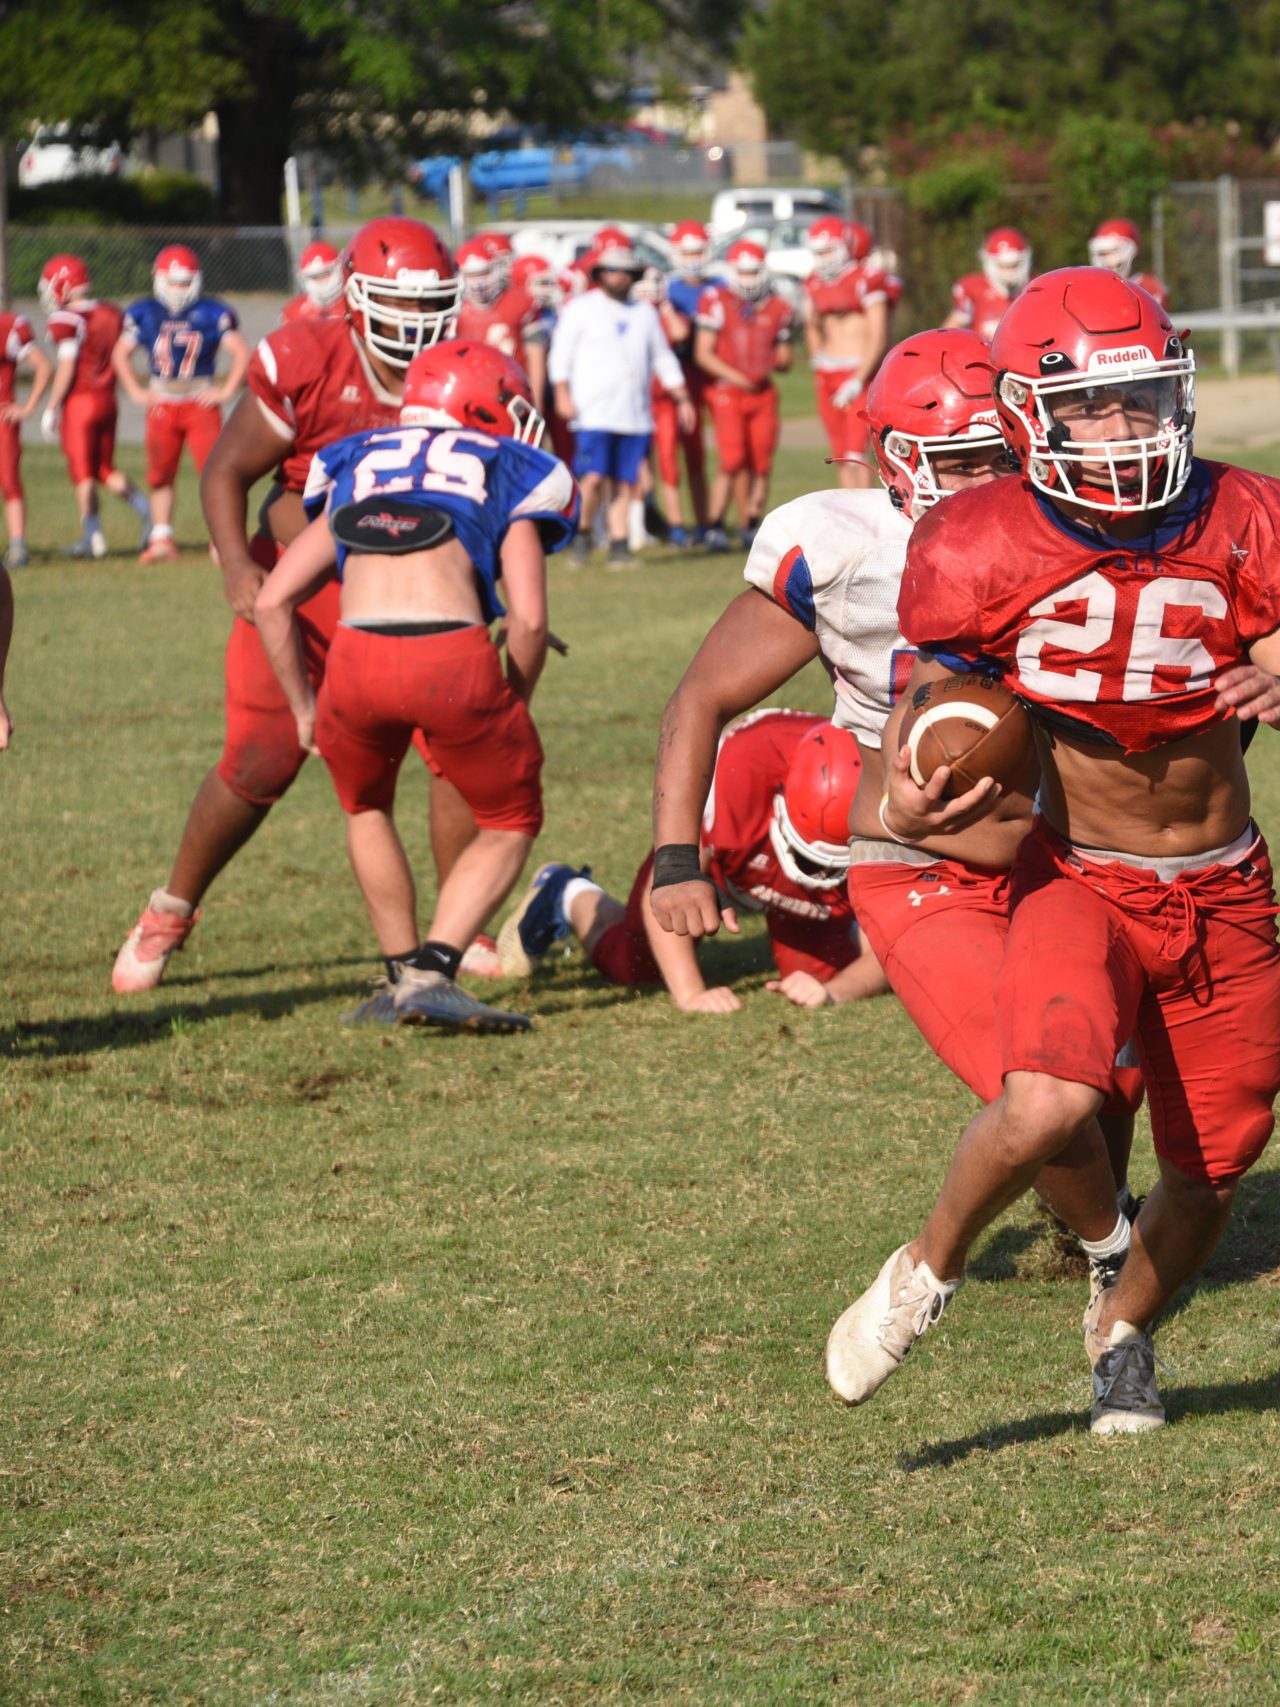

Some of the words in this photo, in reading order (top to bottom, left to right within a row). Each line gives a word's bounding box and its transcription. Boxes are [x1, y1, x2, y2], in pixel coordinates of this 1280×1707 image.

[1096, 348, 1148, 366] Riddell
[343, 427, 500, 505] 25
[1015, 570, 1229, 703] 26
